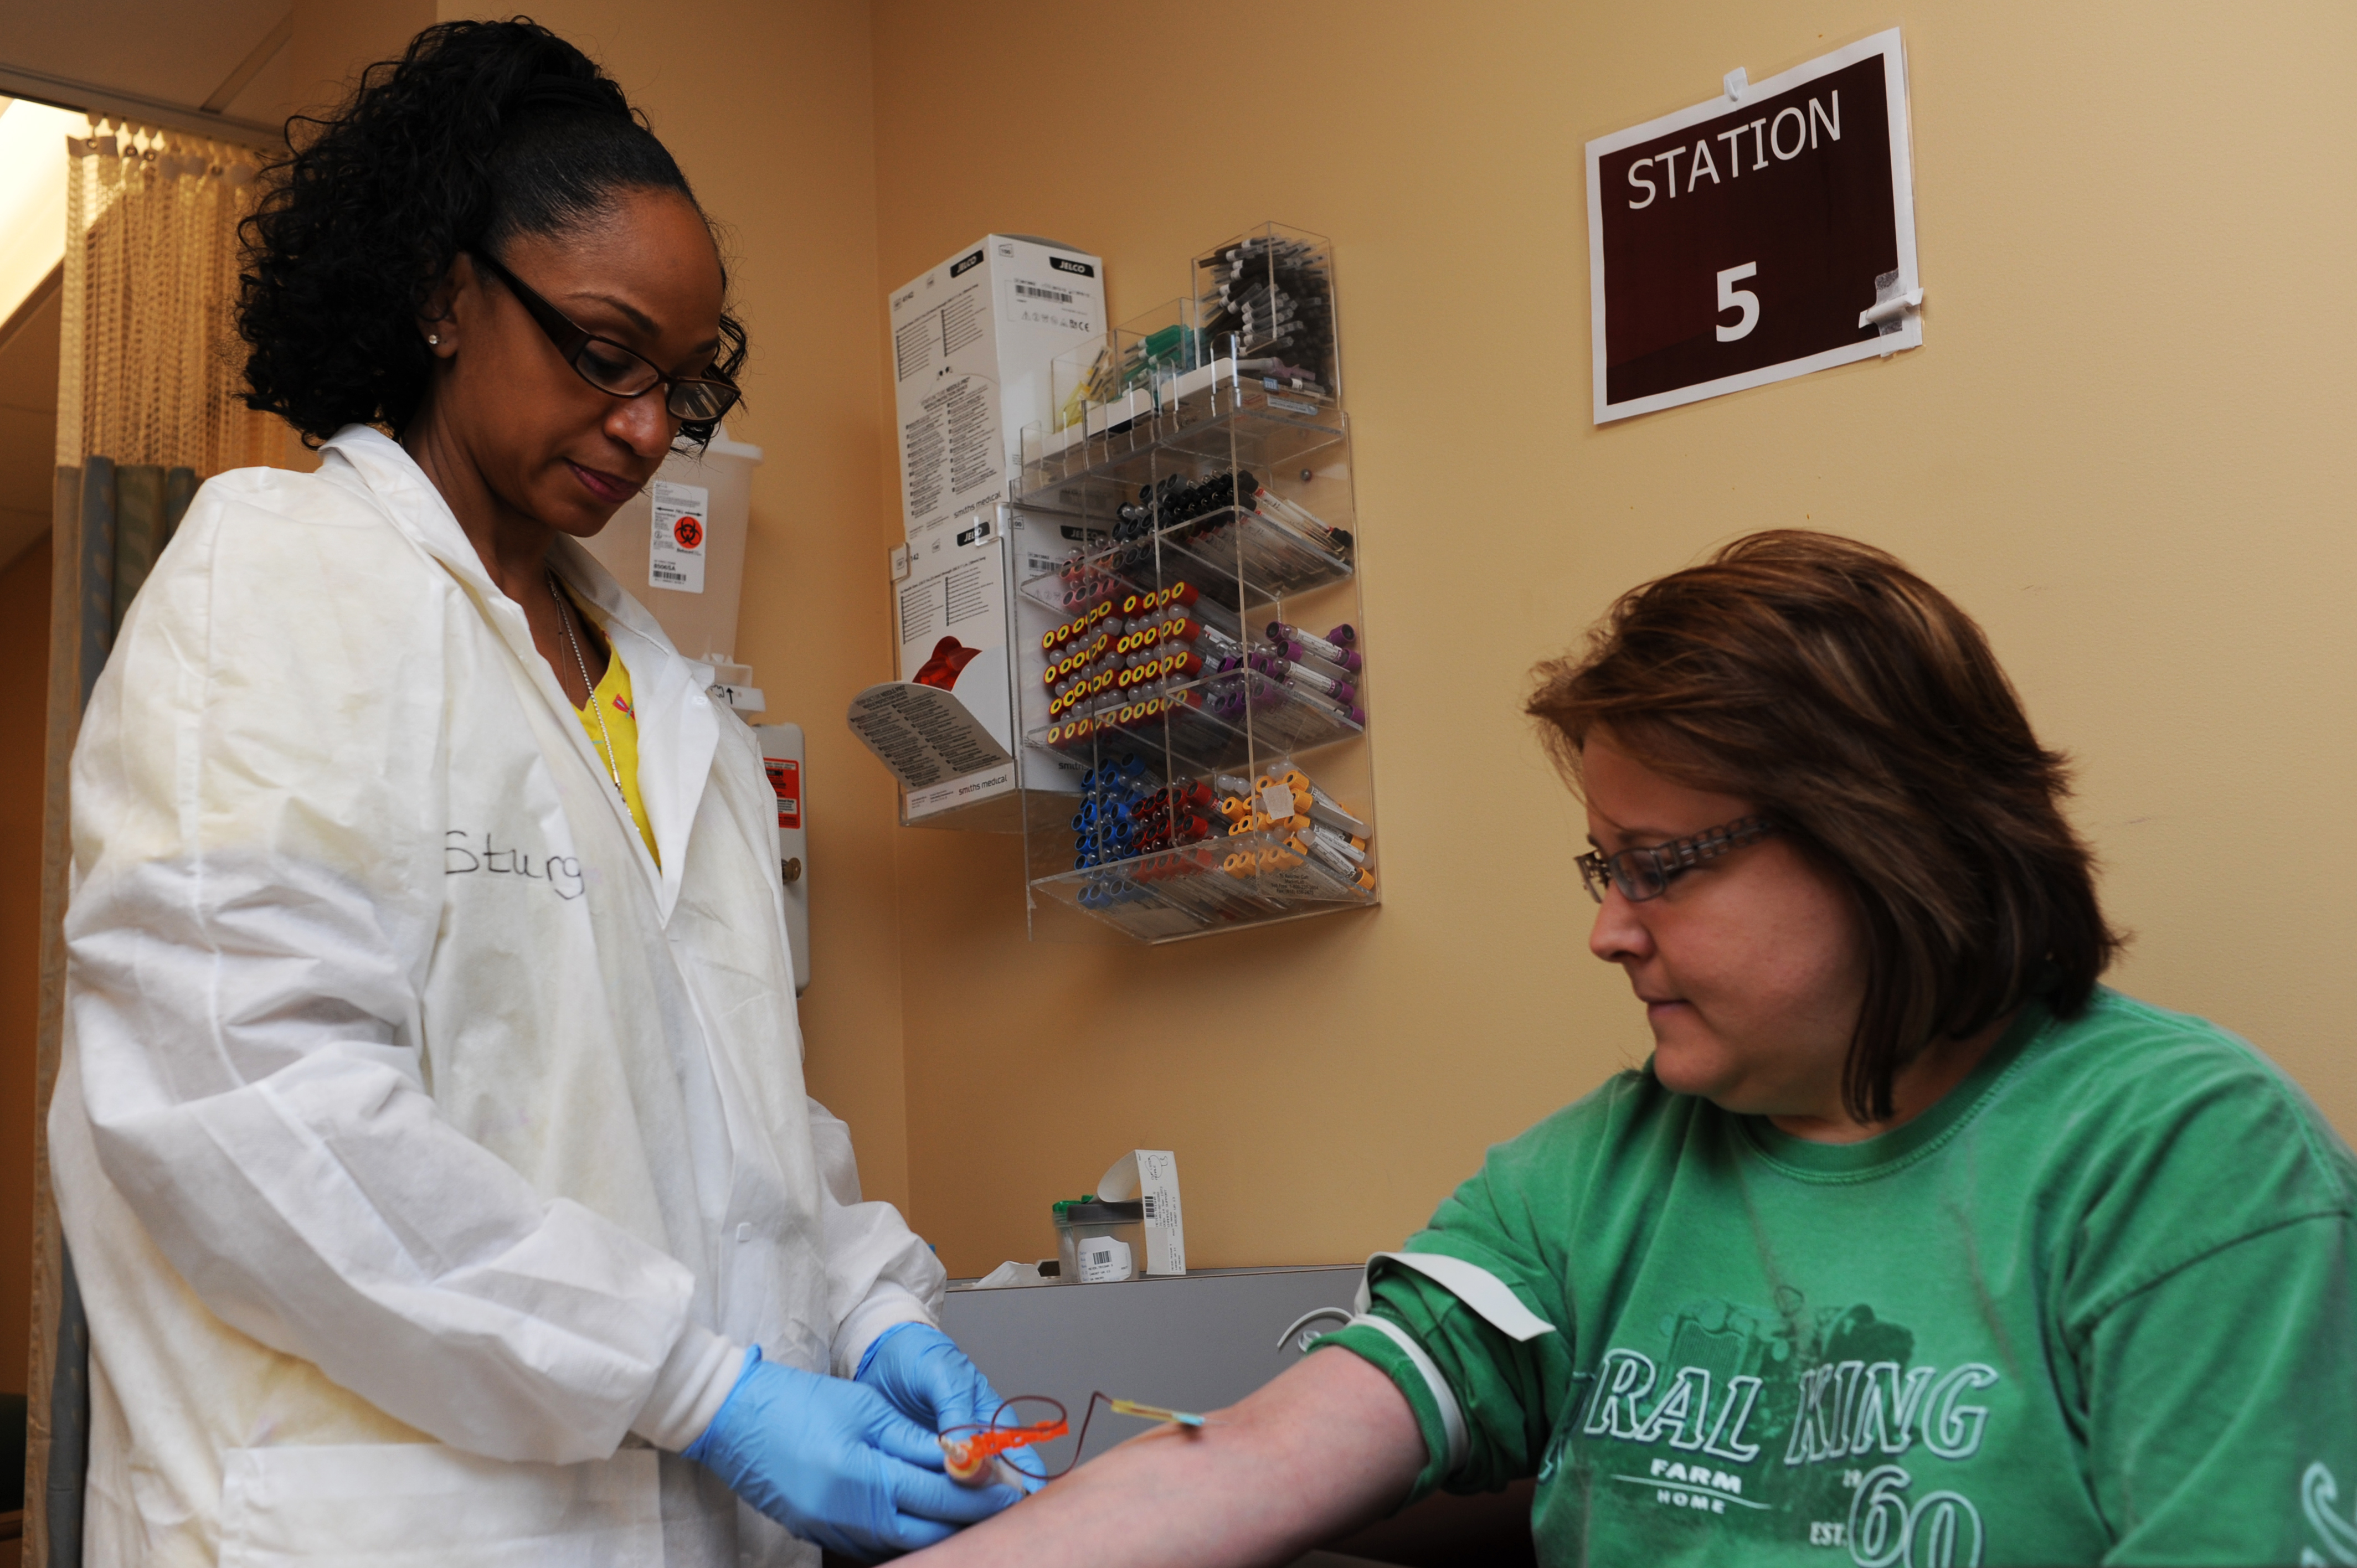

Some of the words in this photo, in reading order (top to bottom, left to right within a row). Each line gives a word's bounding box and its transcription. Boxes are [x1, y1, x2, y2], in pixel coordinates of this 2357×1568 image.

[1628, 90, 1840, 209] STATION
[956, 255, 977, 274] JELCO
[1059, 261, 1085, 274] JELCO
[1716, 261, 1760, 342] 5
[954, 504, 975, 519] smiths
[976, 491, 1001, 509] medical
[964, 527, 982, 542] JELO
[959, 783, 980, 796] smiths
[981, 775, 1007, 789] medical
[445, 830, 585, 900] Sturg
[1572, 1348, 1763, 1463] RAL
[1784, 1360, 1999, 1464] KING
[1650, 1458, 1742, 1494] FARM
[1656, 1489, 1726, 1514] HOME
[1847, 1464, 1983, 1568] 60
[1809, 1521, 1848, 1547] EST.
